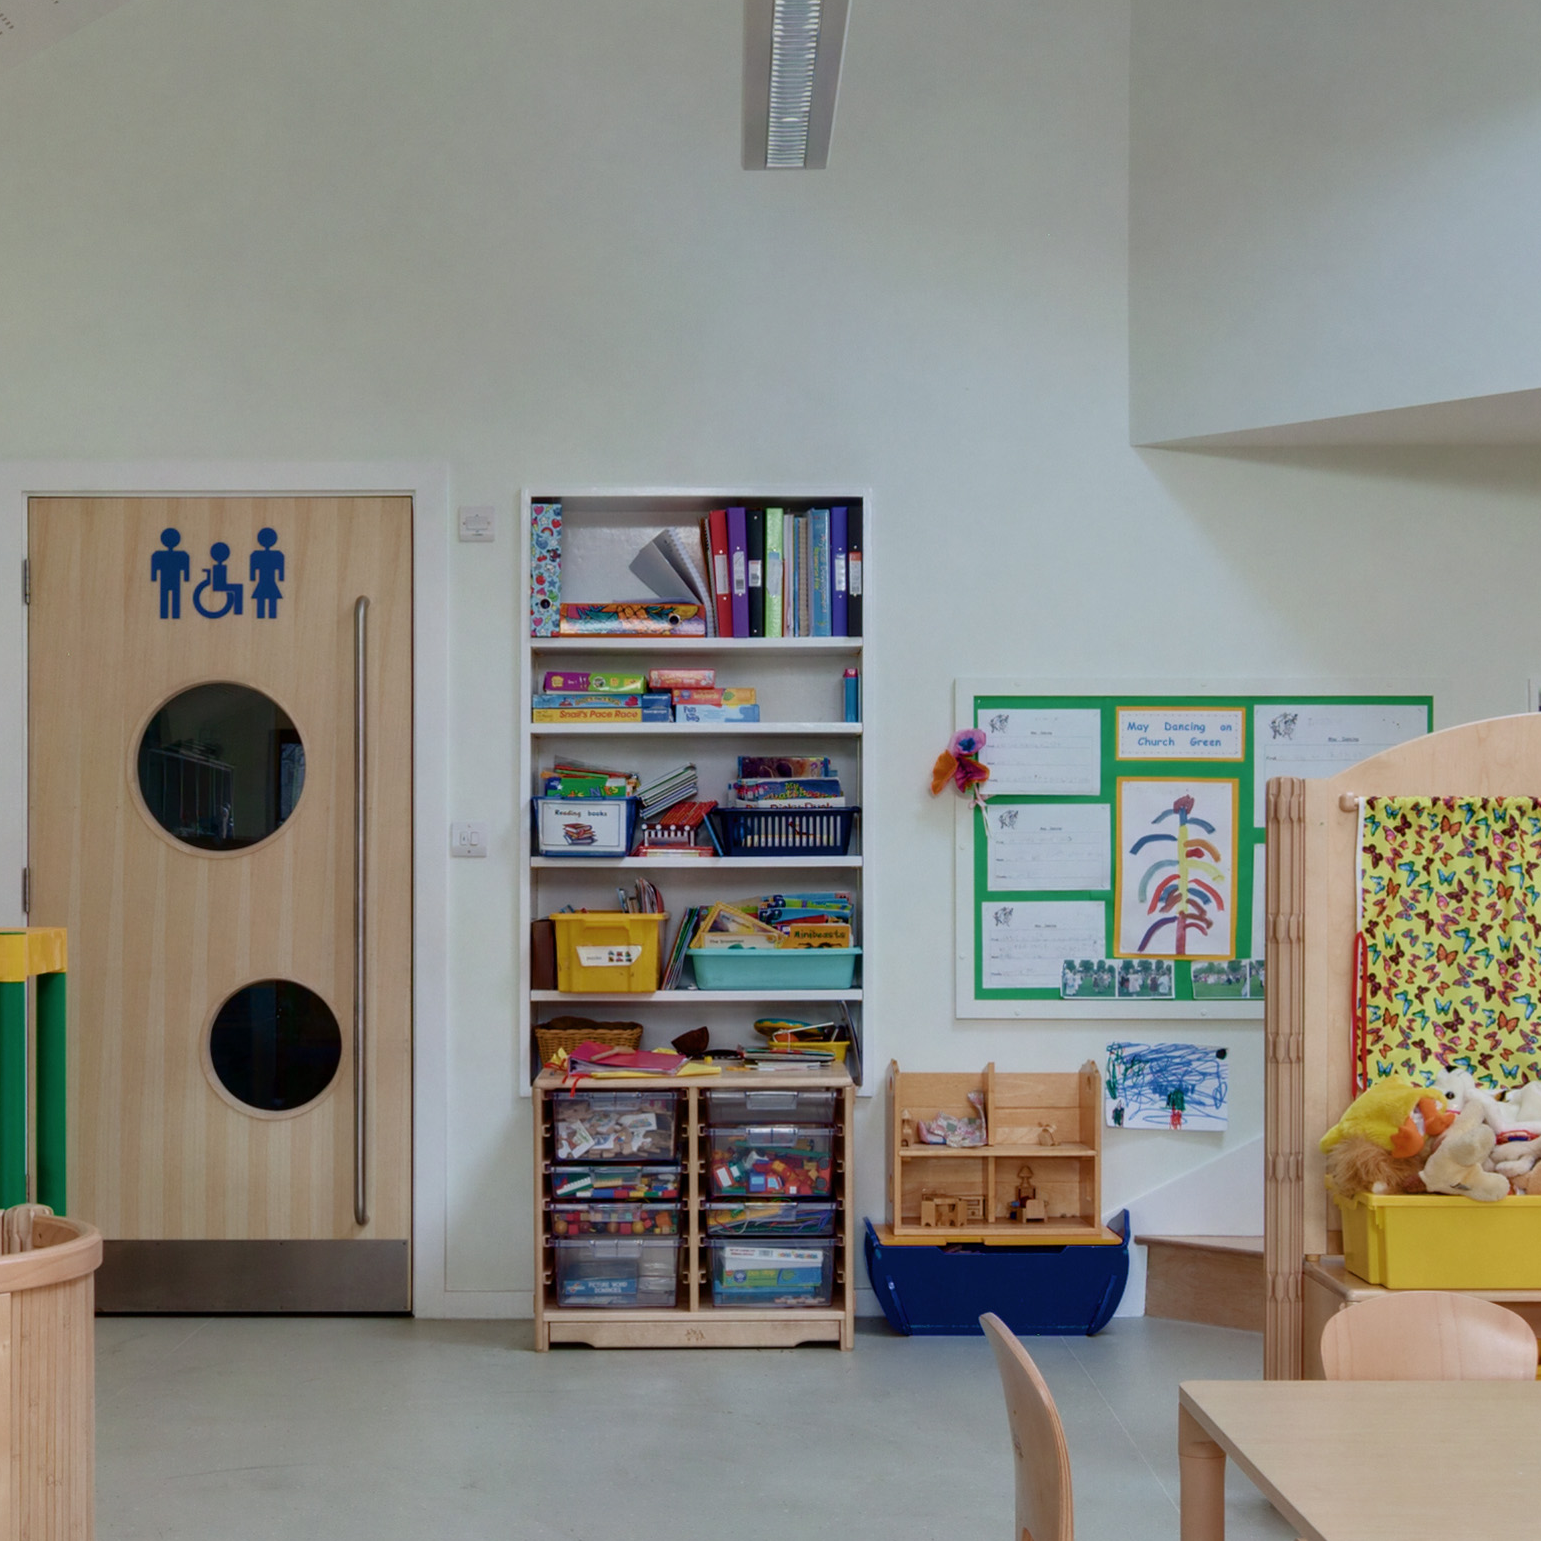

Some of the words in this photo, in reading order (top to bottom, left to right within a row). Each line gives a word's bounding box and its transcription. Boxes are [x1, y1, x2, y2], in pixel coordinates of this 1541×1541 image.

[559, 710, 588, 719] Snail's
[589, 710, 613, 719] Pace
[614, 710, 638, 719] Race
[1127, 721, 1149, 732] May
[1164, 721, 1206, 733] Dancing
[1138, 737, 1175, 746] Church
[1190, 737, 1221, 747] Green
[555, 809, 581, 818] Reading
[794, 930, 847, 939] Minibeasts
